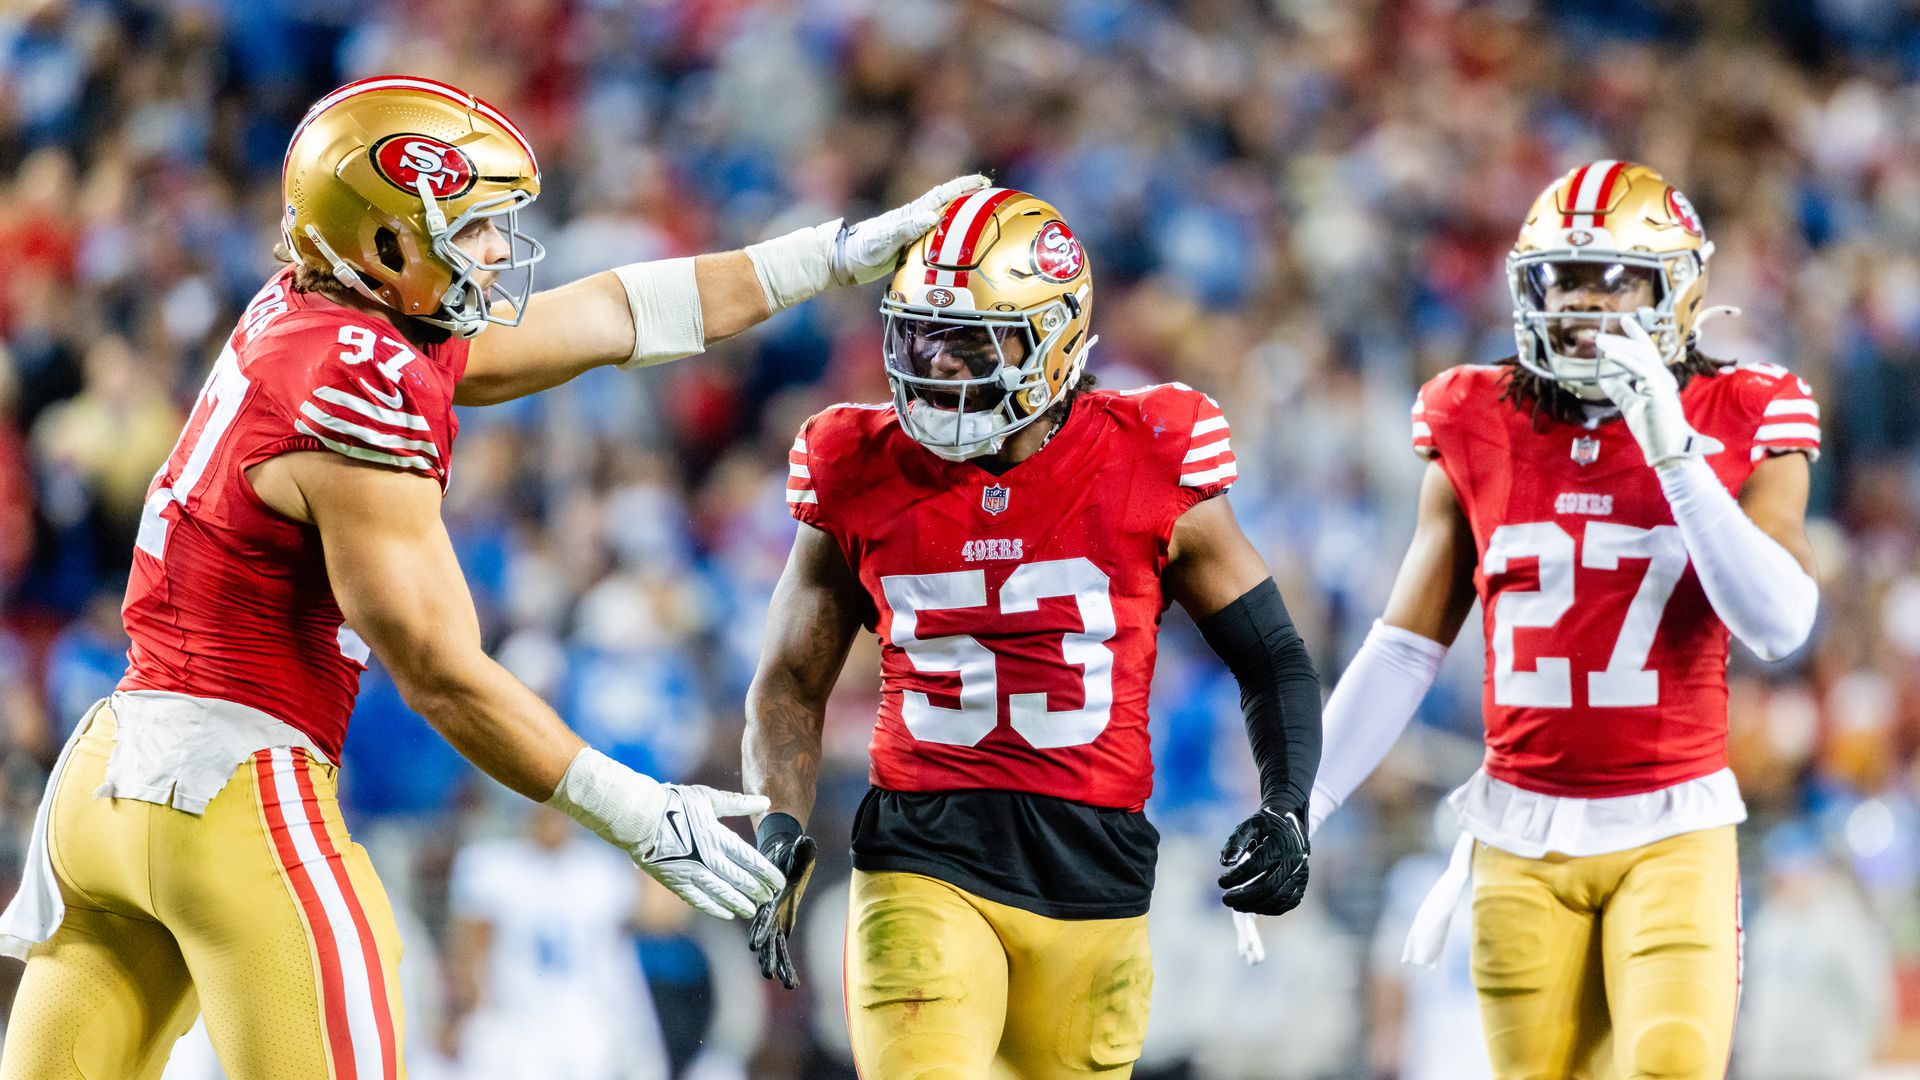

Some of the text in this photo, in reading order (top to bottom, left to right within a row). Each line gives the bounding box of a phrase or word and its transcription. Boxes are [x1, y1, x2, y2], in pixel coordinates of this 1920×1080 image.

[311, 234, 321, 244] 97
[242, 276, 289, 343] OSA
[337, 325, 417, 384] 97
[961, 538, 1024, 562] 49ERS
[1483, 520, 1689, 708] 27
[881, 557, 1117, 749] 53
